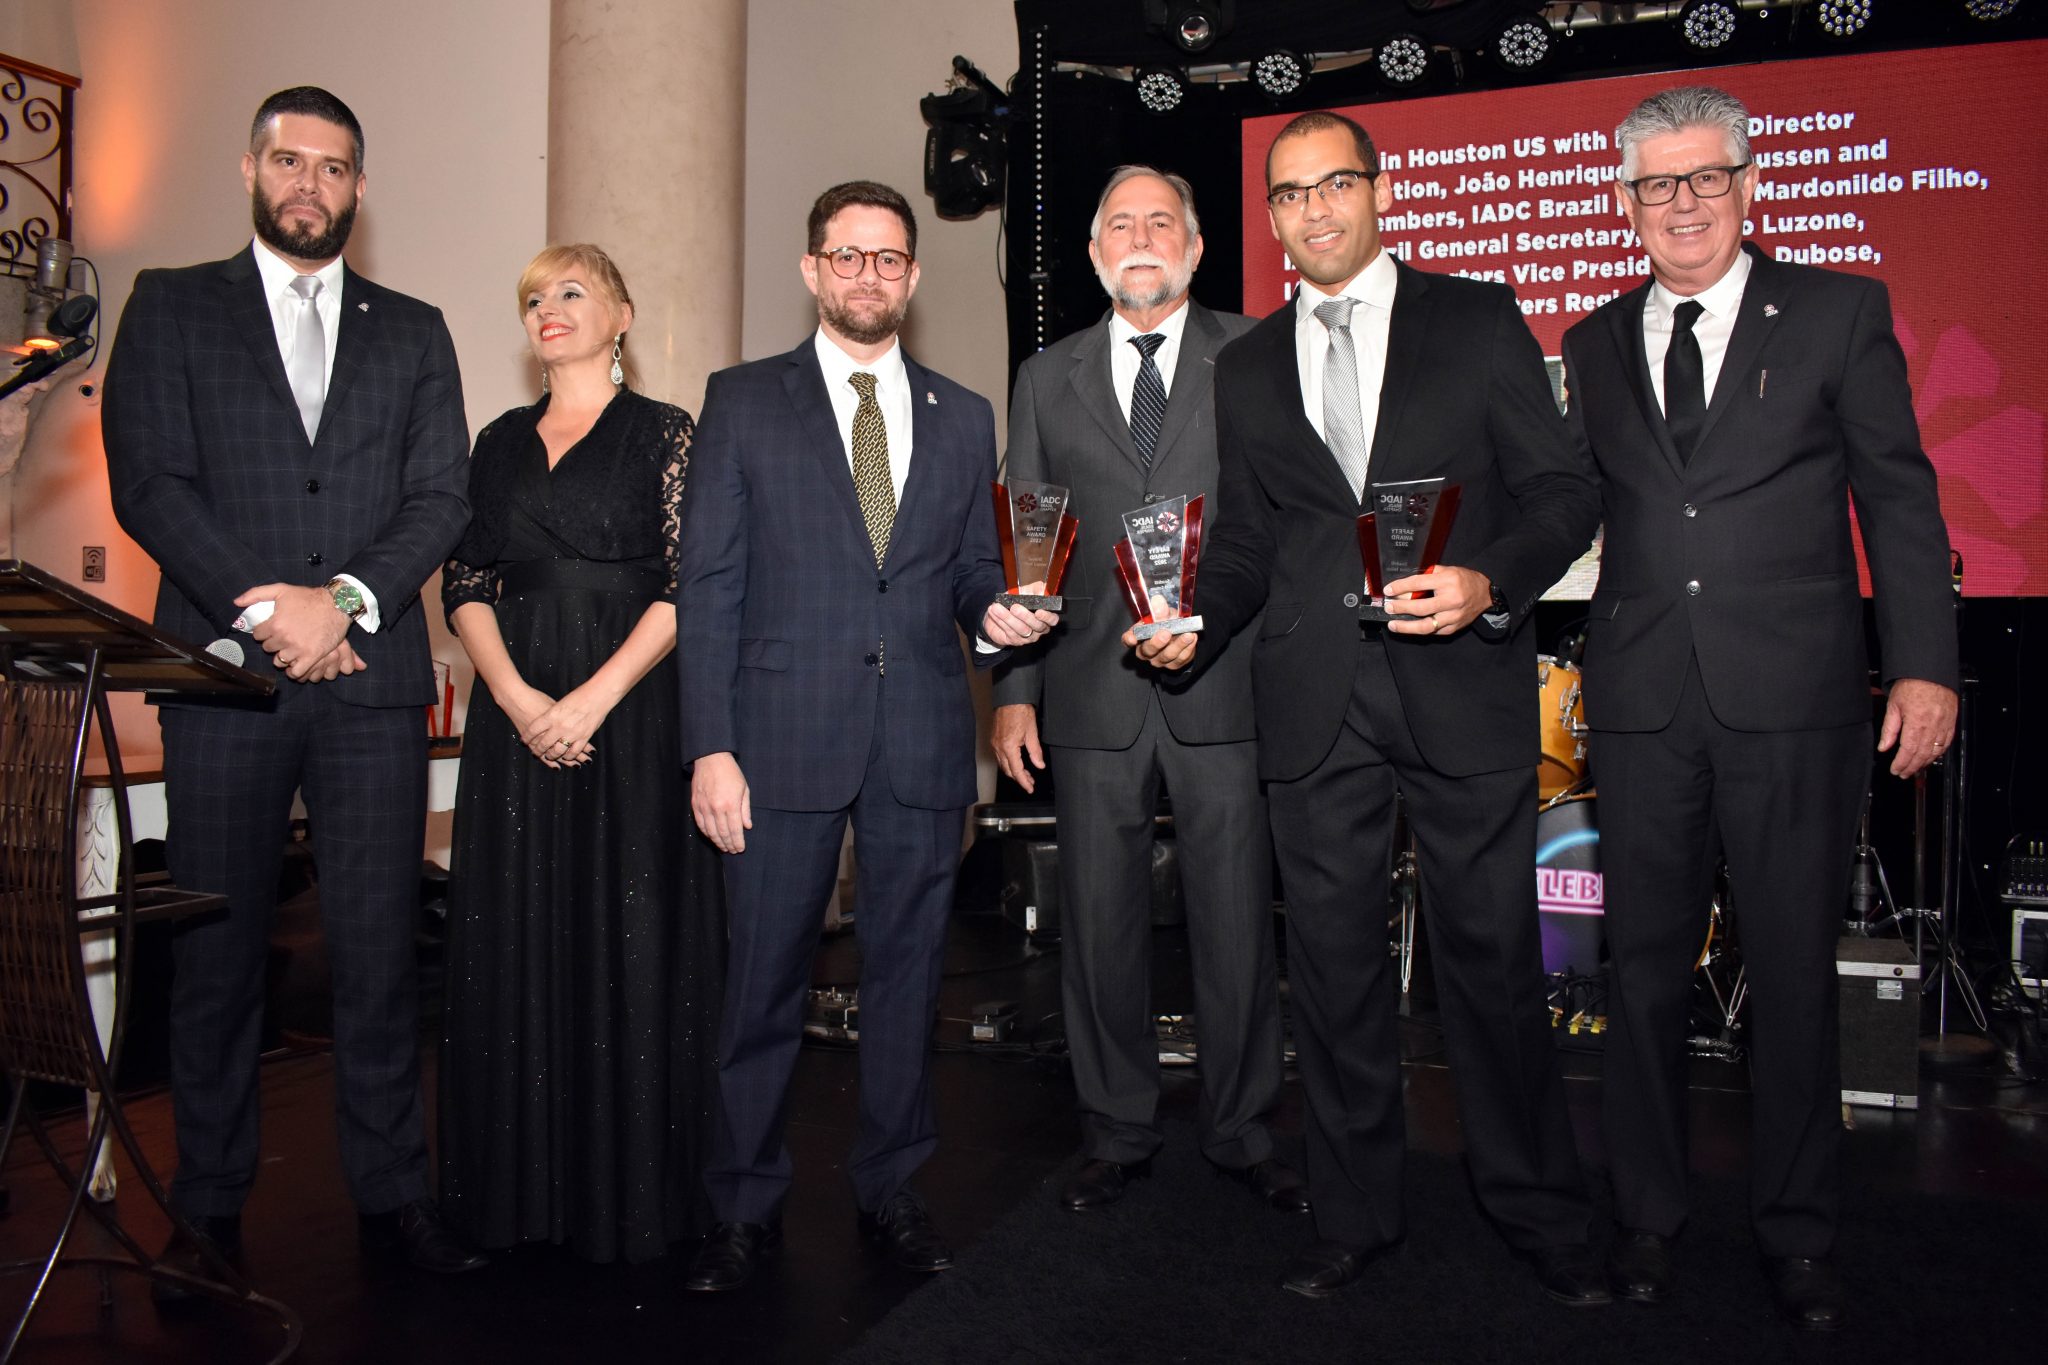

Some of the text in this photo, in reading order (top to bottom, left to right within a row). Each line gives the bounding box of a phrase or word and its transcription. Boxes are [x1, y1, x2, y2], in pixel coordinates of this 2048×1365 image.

[1407, 143, 1507, 168] Houston
[1513, 136, 1546, 158] US
[1553, 130, 1607, 154] with
[1748, 111, 1855, 138] Director
[1391, 178, 1448, 201] tion,
[1454, 170, 1511, 195] João
[1755, 147, 1830, 170] ussen
[1838, 139, 1888, 164] and
[1377, 209, 1465, 233] embers,
[1472, 200, 1532, 225] IADC
[1539, 193, 1608, 219] Brazil
[1754, 171, 1904, 202] Mardonildo
[1912, 166, 1989, 192] Filho,
[1418, 232, 1509, 260] General
[1515, 227, 1641, 253] Secretary,
[1762, 212, 1865, 234] Luzone,
[1512, 262, 1565, 284] Vice
[1573, 254, 1651, 280] Presid
[1775, 243, 1882, 265] Dubose,
[1040, 496, 1061, 504] IADC
[1537, 868, 1603, 903] LEB
